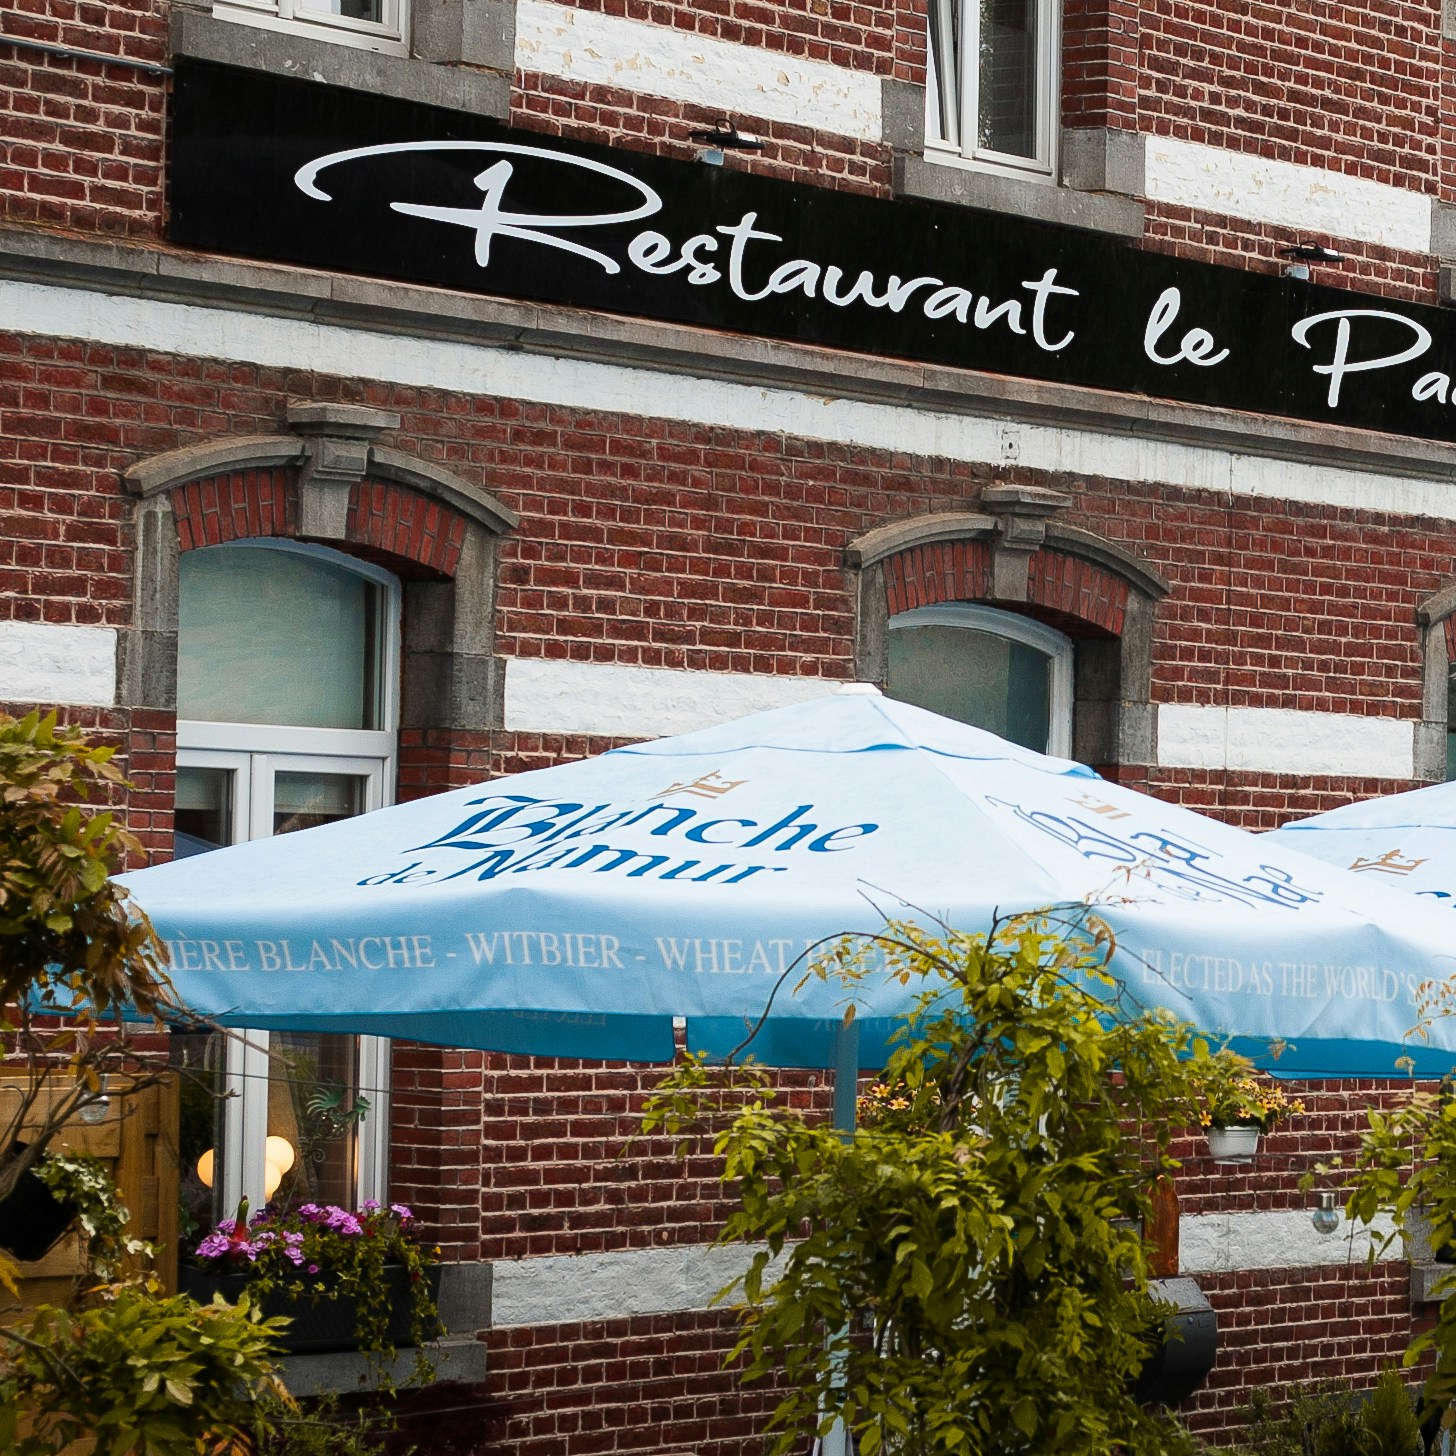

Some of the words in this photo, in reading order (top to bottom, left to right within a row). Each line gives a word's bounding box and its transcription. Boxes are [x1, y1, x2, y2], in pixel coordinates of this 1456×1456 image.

[294, 140, 1079, 351] Restaurant
[1143, 286, 1230, 367] le
[401, 795, 880, 854] Blanche
[356, 862, 437, 886] de
[426, 843, 789, 884] Namur
[164, 930, 250, 972] IÈRE
[257, 934, 436, 971] BLANCHE
[465, 931, 626, 969] WITBIER
[655, 937, 794, 975] WHEAT
[1141, 947, 1244, 993] ELECTED
[1248, 959, 1274, 995] AS
[1279, 962, 1318, 998] THE
